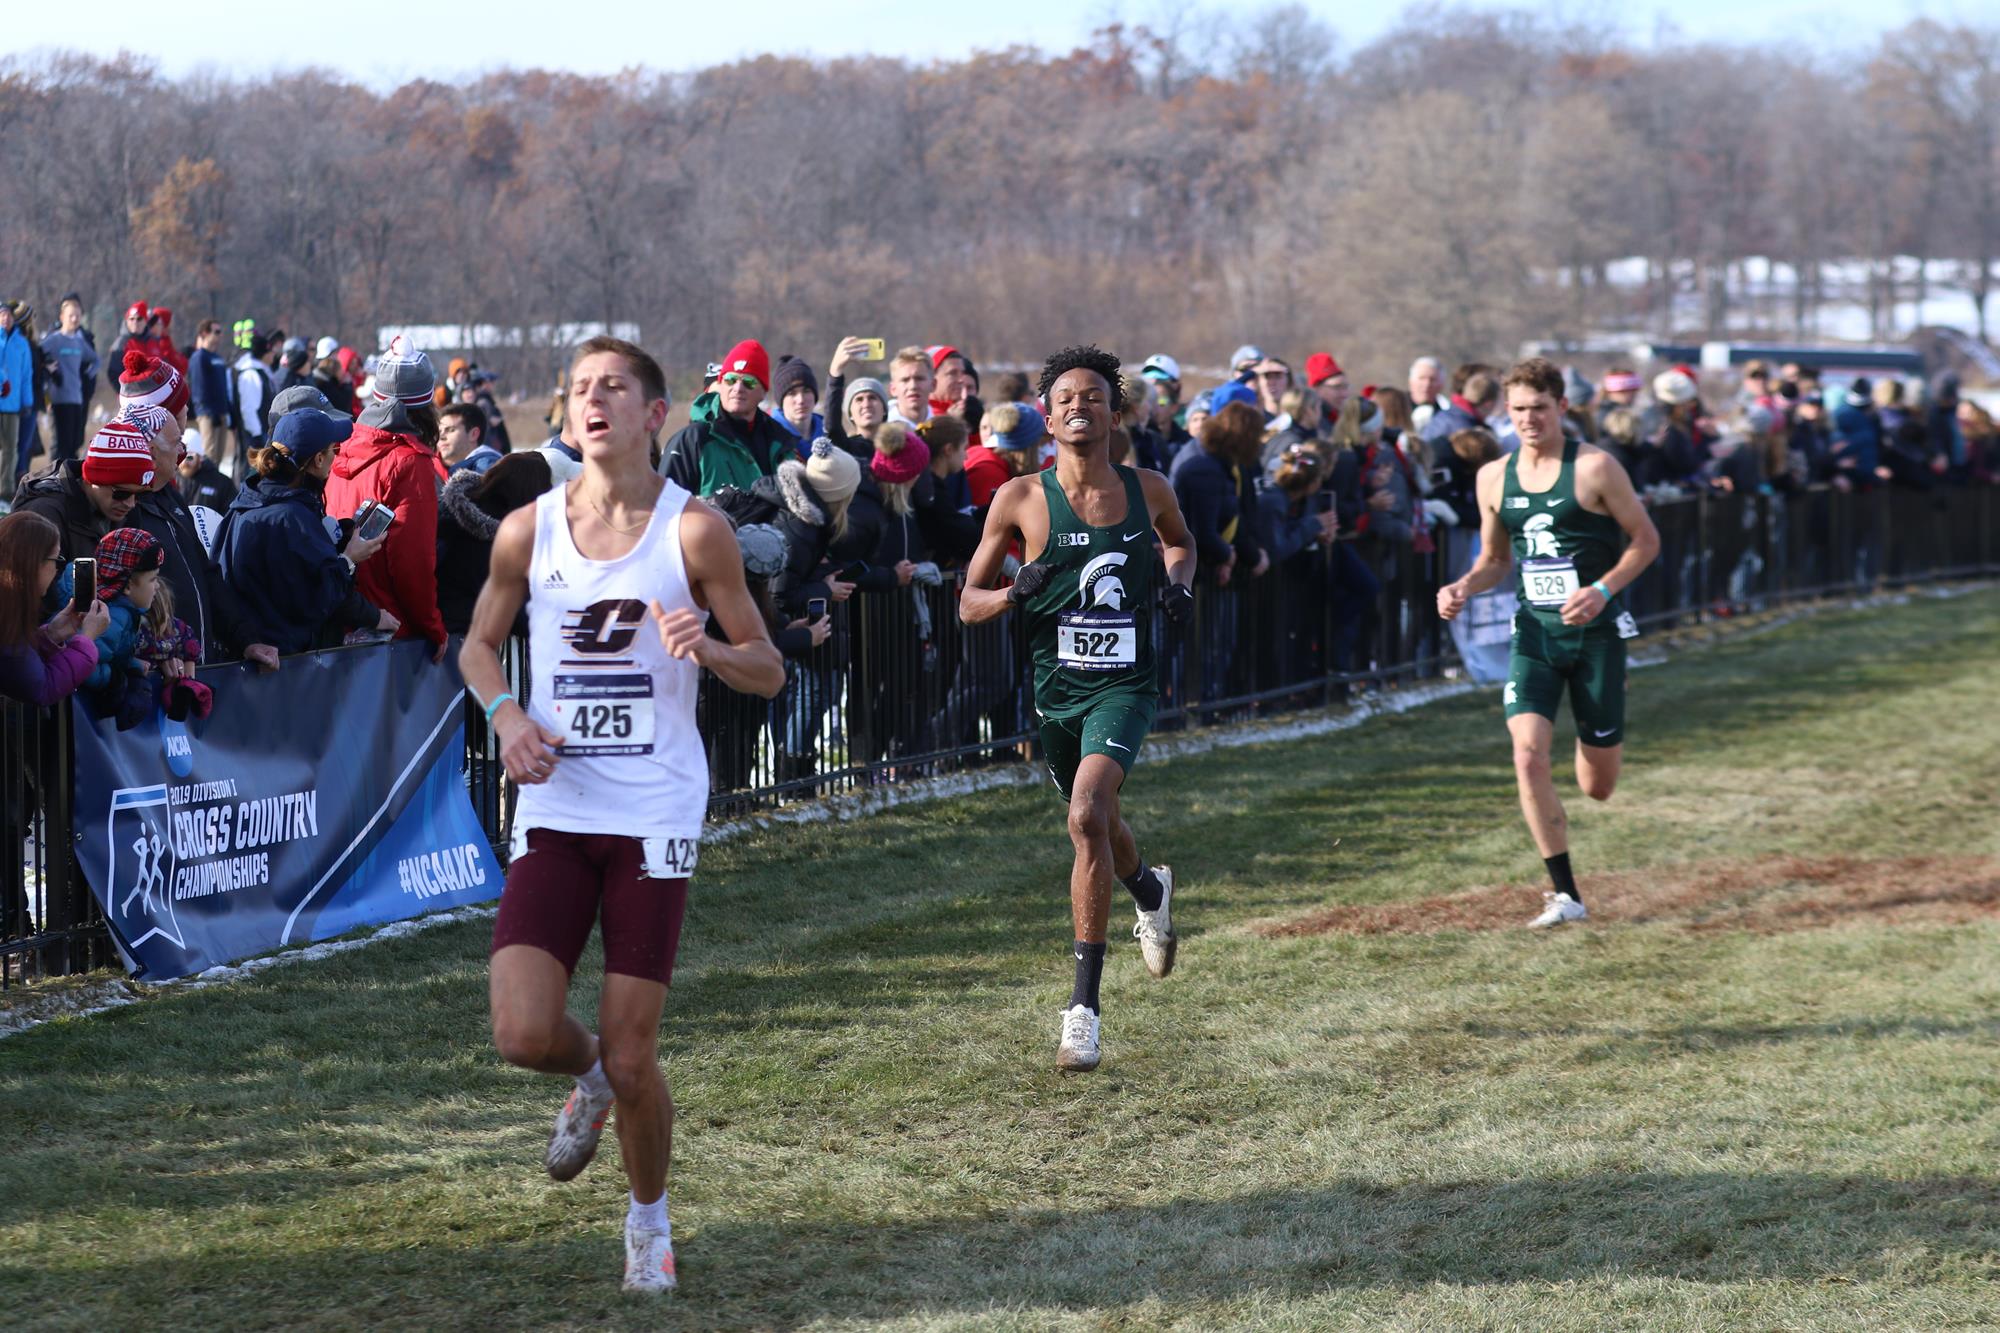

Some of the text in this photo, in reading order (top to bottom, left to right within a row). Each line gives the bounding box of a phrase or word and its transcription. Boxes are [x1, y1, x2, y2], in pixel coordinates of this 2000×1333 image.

[1533, 575, 1566, 596] 529
[1073, 631, 1120, 657] 522
[571, 704, 633, 739] 425
[166, 735, 192, 757] NCAA
[170, 778, 238, 806] 2019 DIVISION I
[174, 790, 319, 861] CROSS COUNTRY
[174, 852, 269, 900] CHAMPIONSHIPS
[398, 843, 486, 900] #NCAAXC
